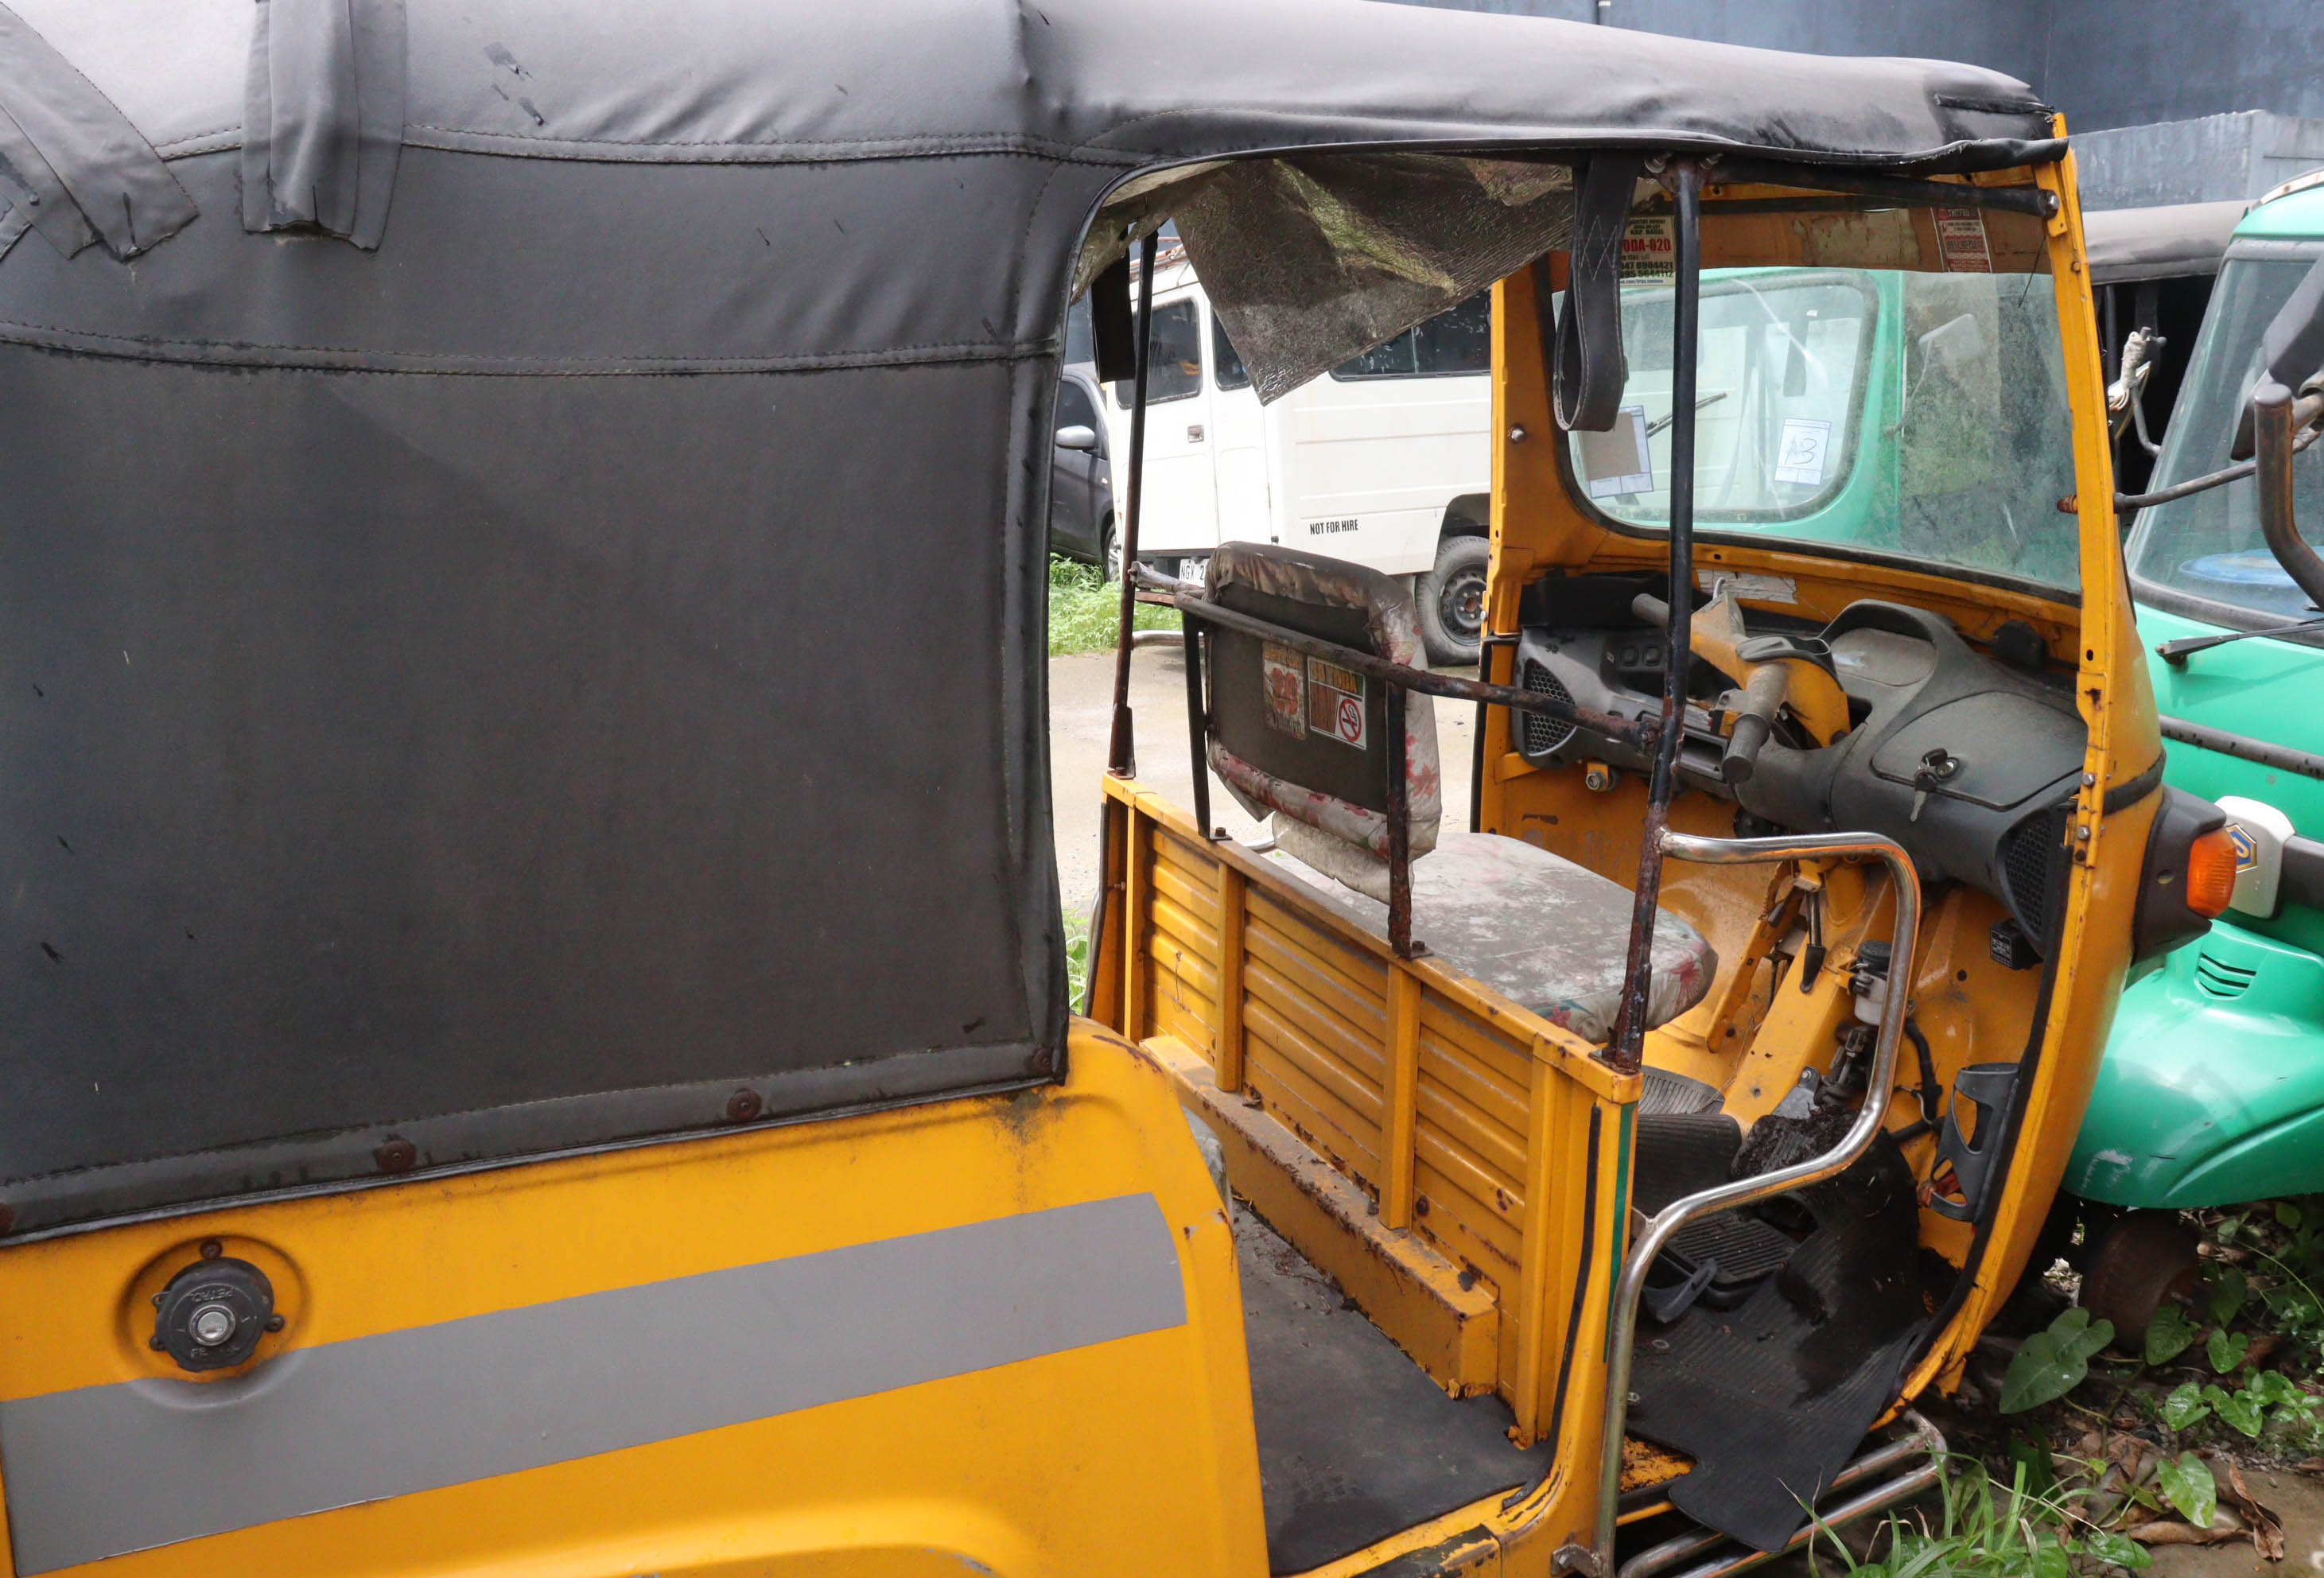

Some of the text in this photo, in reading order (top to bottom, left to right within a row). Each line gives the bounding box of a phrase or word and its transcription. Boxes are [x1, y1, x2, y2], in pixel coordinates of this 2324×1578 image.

[1623, 238, 1671, 252] ODA-020
[1309, 519, 1359, 535] NOT FOR HIRE
[1180, 565, 1195, 580] NGX
